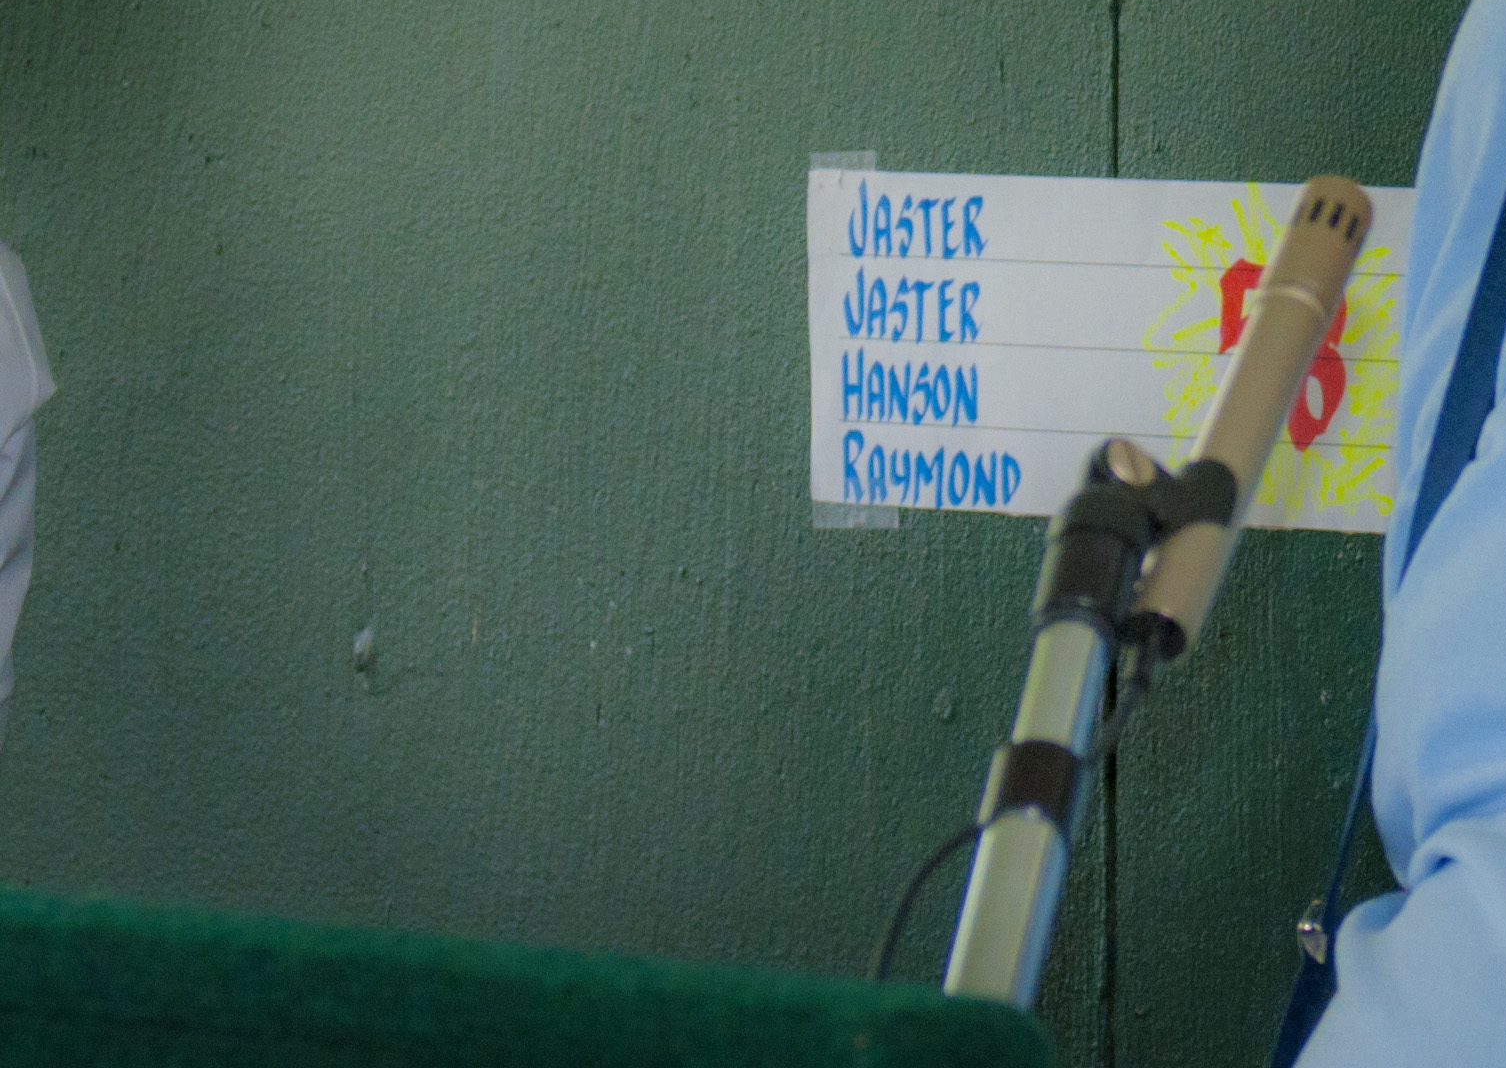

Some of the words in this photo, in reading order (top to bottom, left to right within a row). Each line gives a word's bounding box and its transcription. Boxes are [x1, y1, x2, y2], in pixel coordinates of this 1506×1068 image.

[847, 179, 988, 260] JASTER
[842, 265, 983, 345] JASTER
[841, 346, 979, 427] HANSON
[841, 429, 1022, 509] RAYMOND
